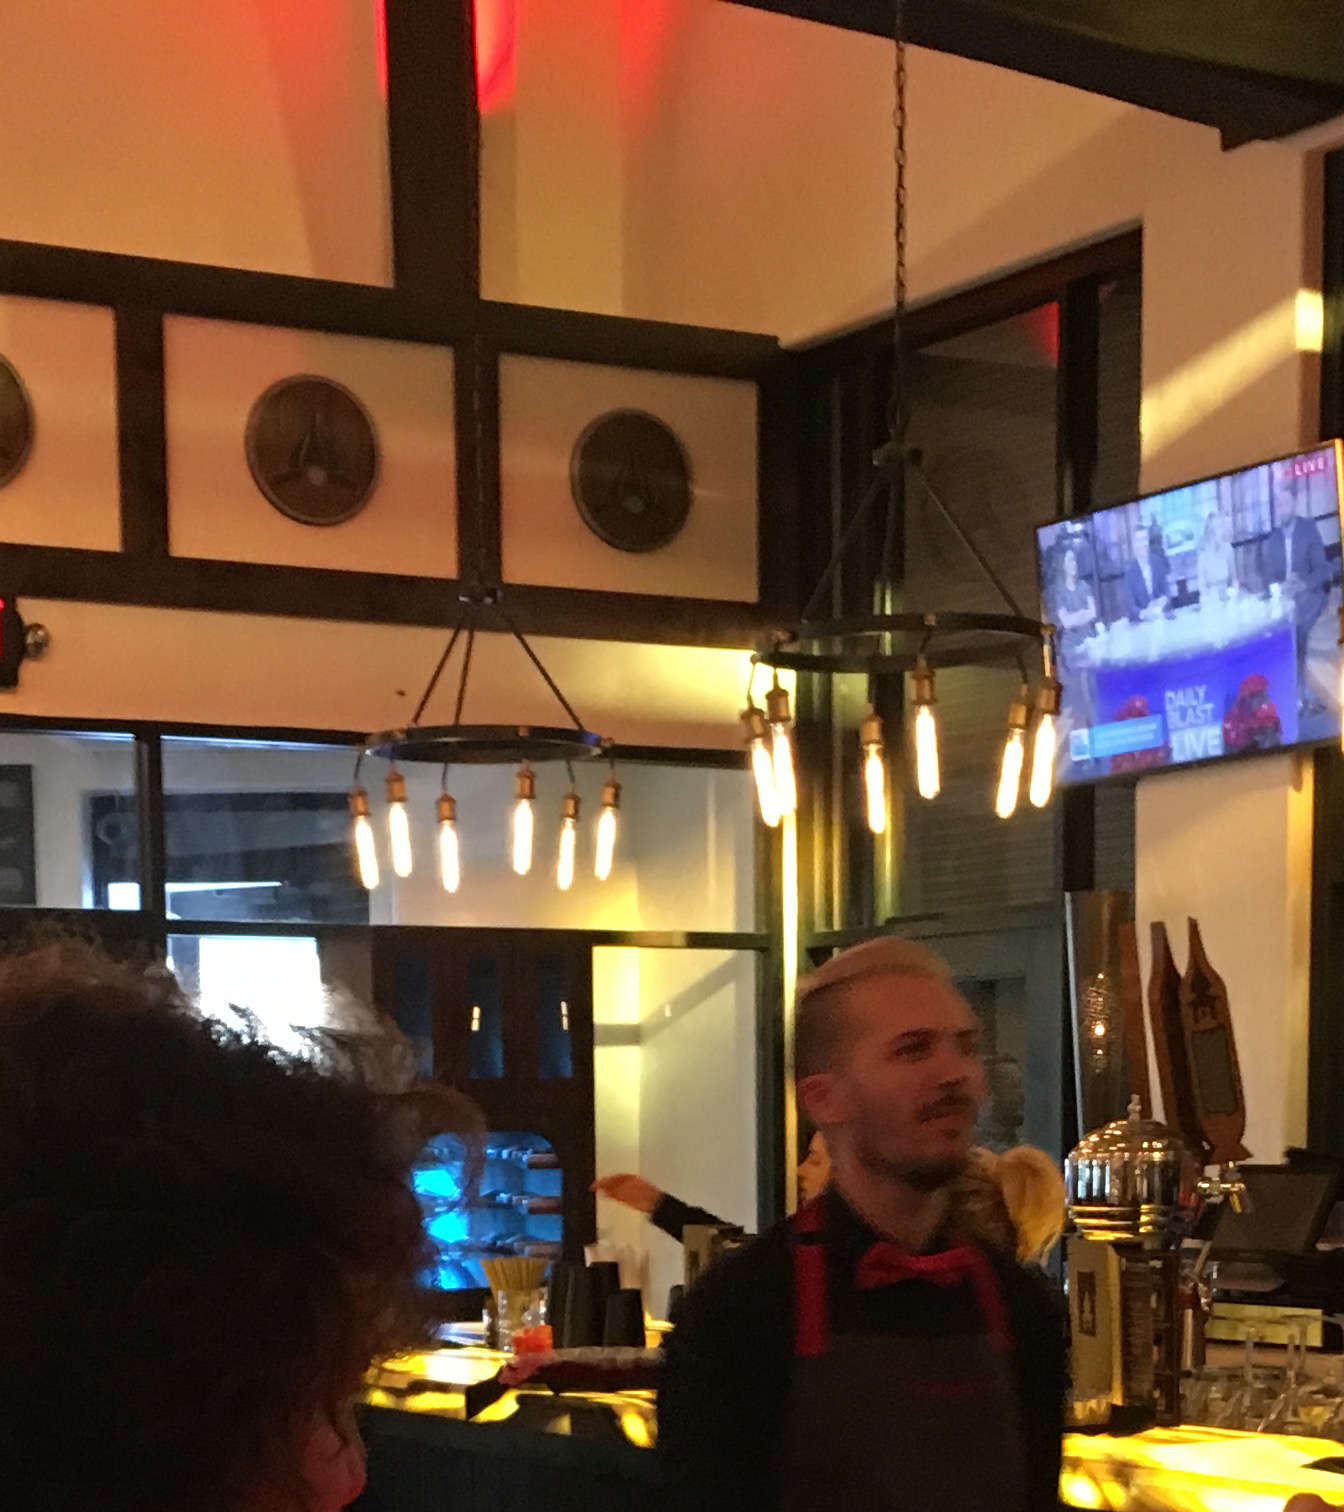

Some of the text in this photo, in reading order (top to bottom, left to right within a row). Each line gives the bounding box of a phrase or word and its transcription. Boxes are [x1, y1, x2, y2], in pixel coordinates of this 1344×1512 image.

[1165, 684, 1207, 711] DAILY
[1166, 703, 1214, 730] BLAST
[1170, 725, 1224, 763] LIVE
